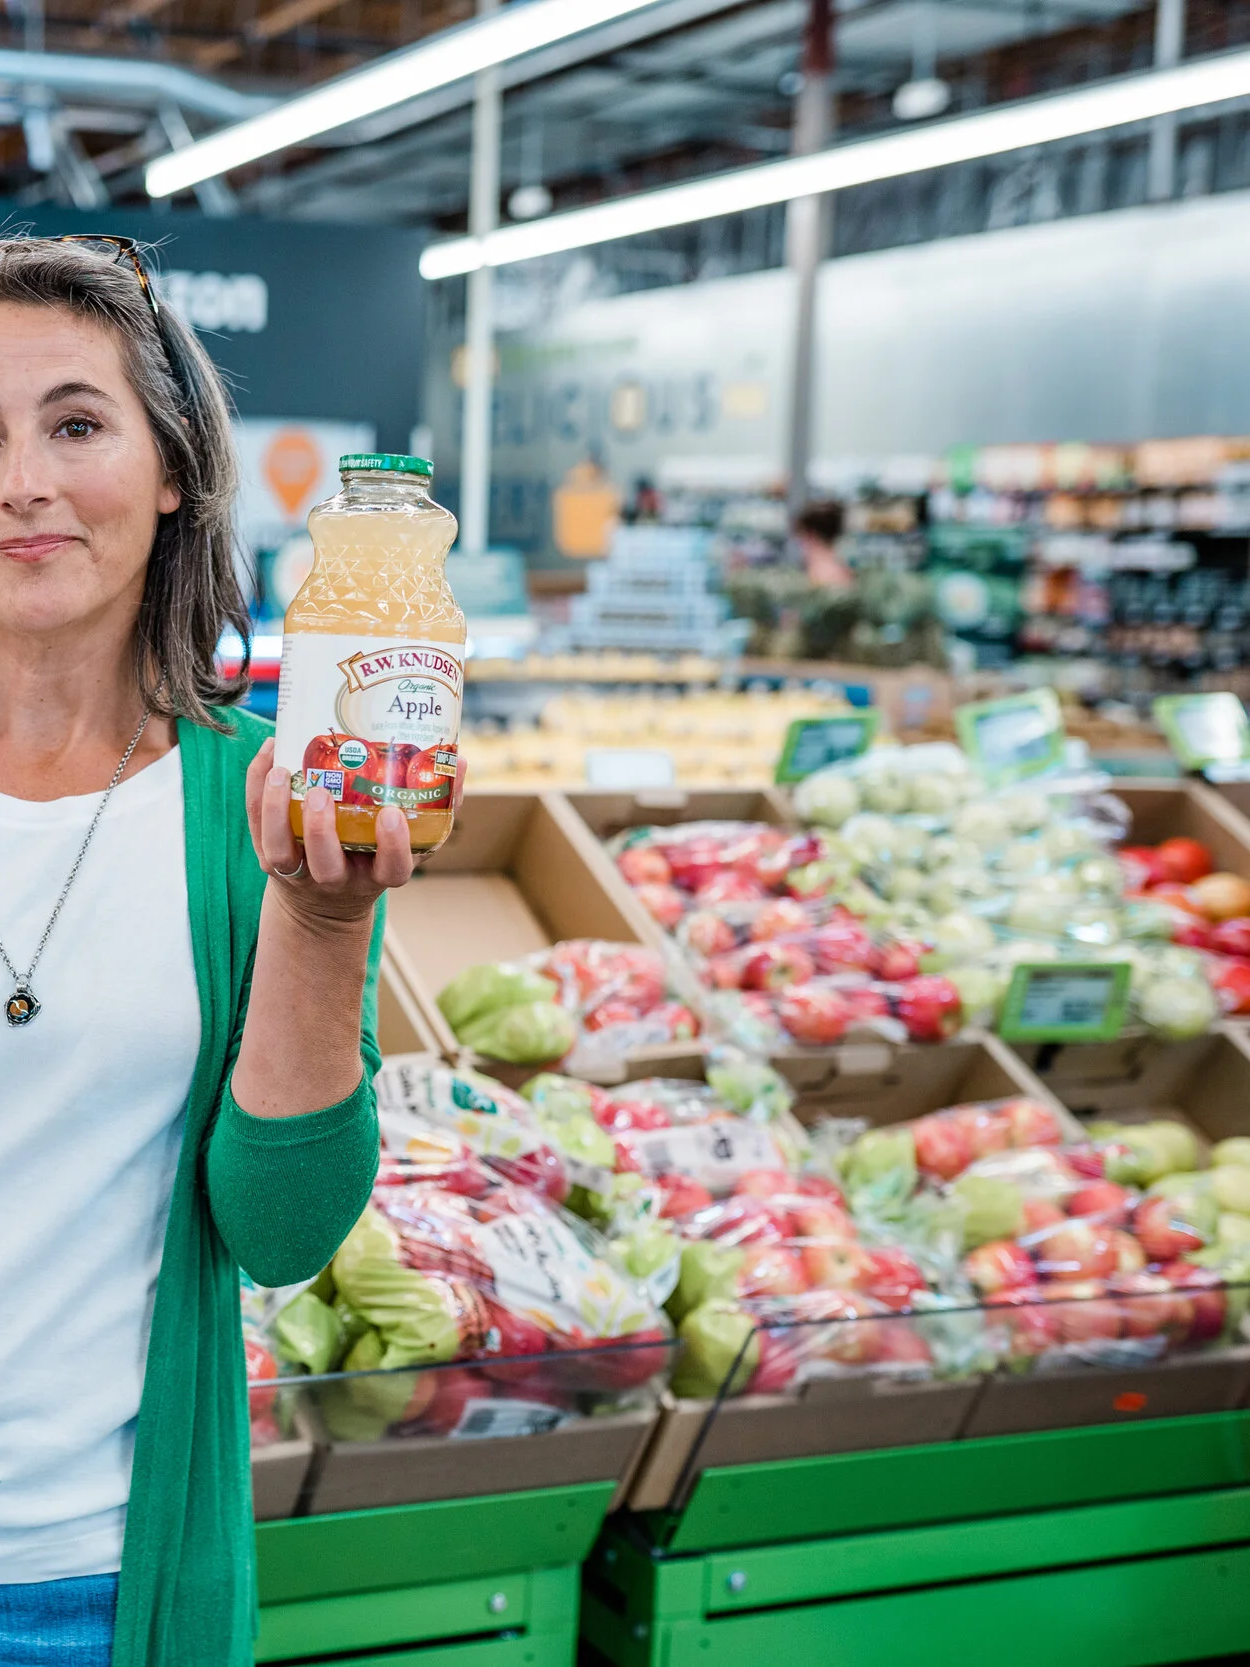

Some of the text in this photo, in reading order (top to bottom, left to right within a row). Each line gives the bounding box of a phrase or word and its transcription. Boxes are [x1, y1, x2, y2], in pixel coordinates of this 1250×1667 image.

[361, 459, 382, 468] SAFETY
[359, 652, 460, 682] R.W. KNUDSEN
[397, 679, 436, 693] Organic
[386, 694, 442, 720] Apple
[345, 746, 362, 754] USDA
[371, 785, 442, 801] ORGANIC
